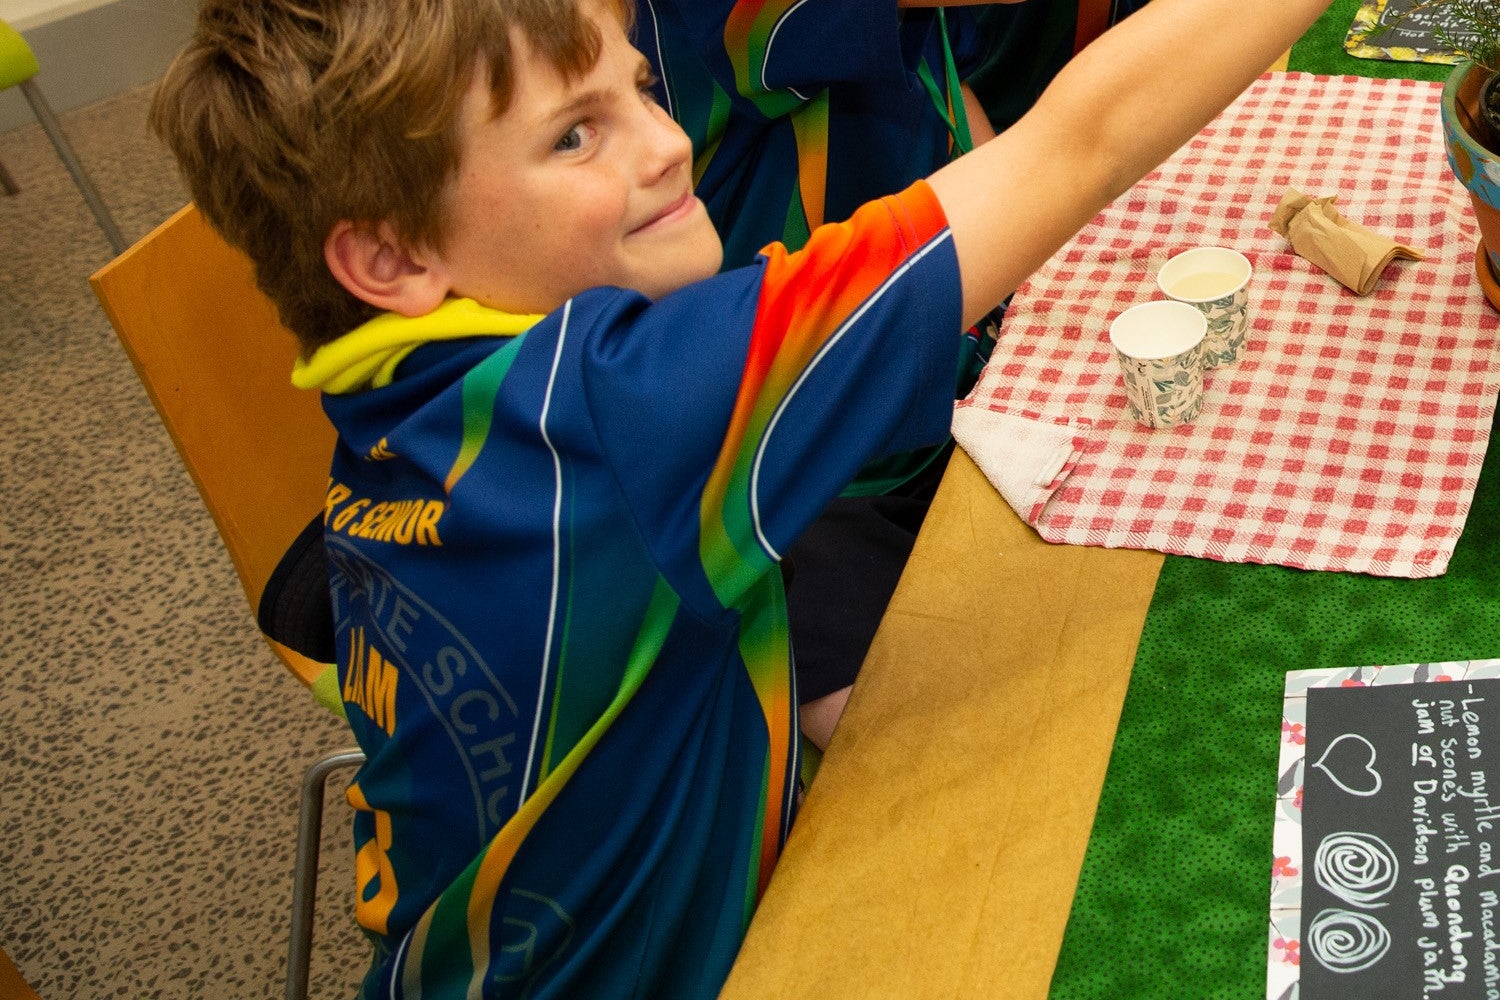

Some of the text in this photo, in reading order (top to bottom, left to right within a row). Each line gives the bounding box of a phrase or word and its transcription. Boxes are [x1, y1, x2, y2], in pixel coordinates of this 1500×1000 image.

[1412, 698, 1436, 735] jam
[1439, 699, 1460, 728] nut
[1415, 744, 1437, 768] or
[1440, 738, 1459, 803] scones
[1412, 779, 1438, 866] Davidson
[1440, 812, 1471, 853] with
[1414, 877, 1441, 929] plum
